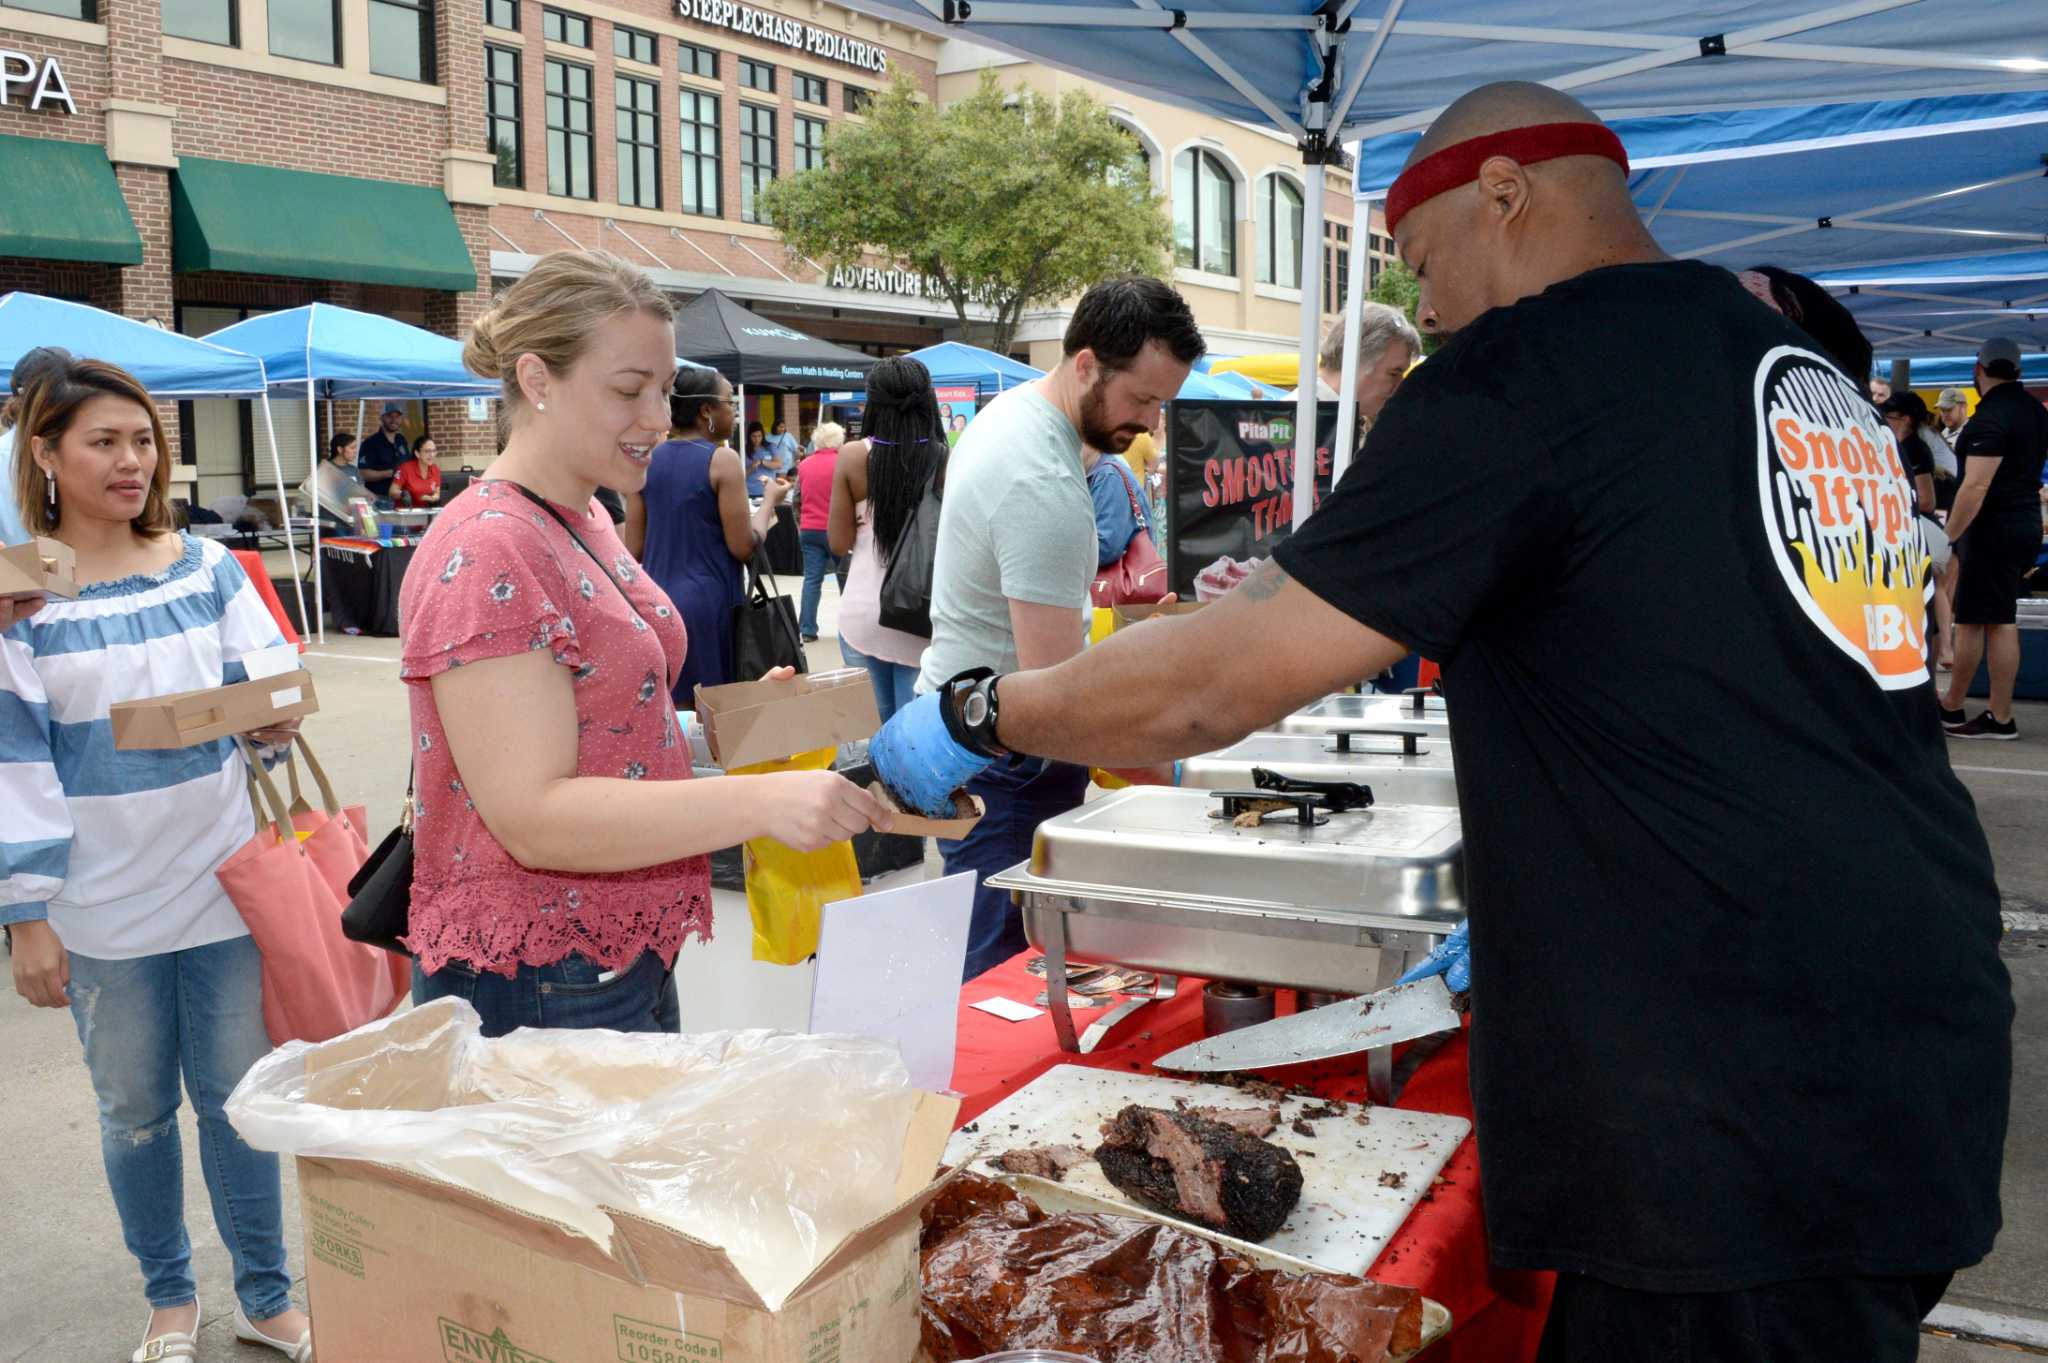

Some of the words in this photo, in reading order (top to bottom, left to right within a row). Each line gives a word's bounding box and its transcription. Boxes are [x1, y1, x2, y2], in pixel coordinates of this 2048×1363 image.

[679, 0, 803, 48] STEEPLECHASE
[805, 26, 889, 73] PEDIATRICS
[832, 263, 922, 297] ADVENTURE
[781, 365, 802, 376] Kumon
[1202, 447, 1329, 508] SMOOTE
[1808, 473, 1853, 528] It
[443, 1323, 541, 1363] ENVI
[618, 1324, 669, 1347] Reorder
[673, 1338, 708, 1357] Code
